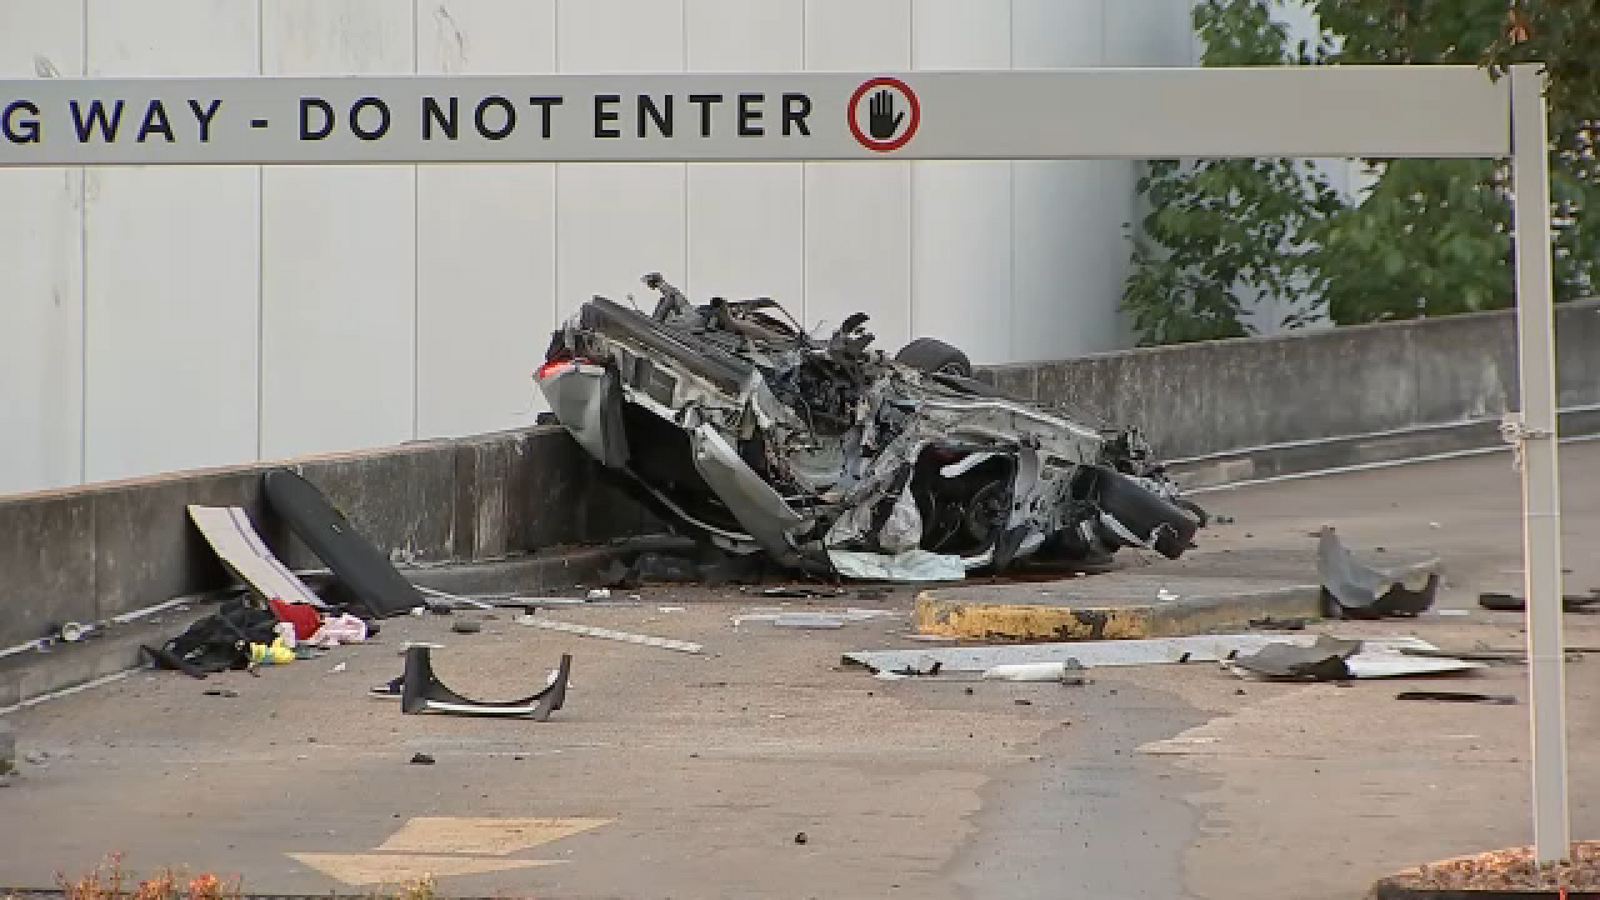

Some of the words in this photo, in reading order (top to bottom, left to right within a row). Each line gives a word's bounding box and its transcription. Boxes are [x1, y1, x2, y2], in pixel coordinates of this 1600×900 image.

[69, 99, 223, 144] WAY
[250, 118, 269, 129] -
[299, 96, 391, 141] DO
[421, 95, 564, 141] NOT
[593, 93, 812, 139] ENTER
